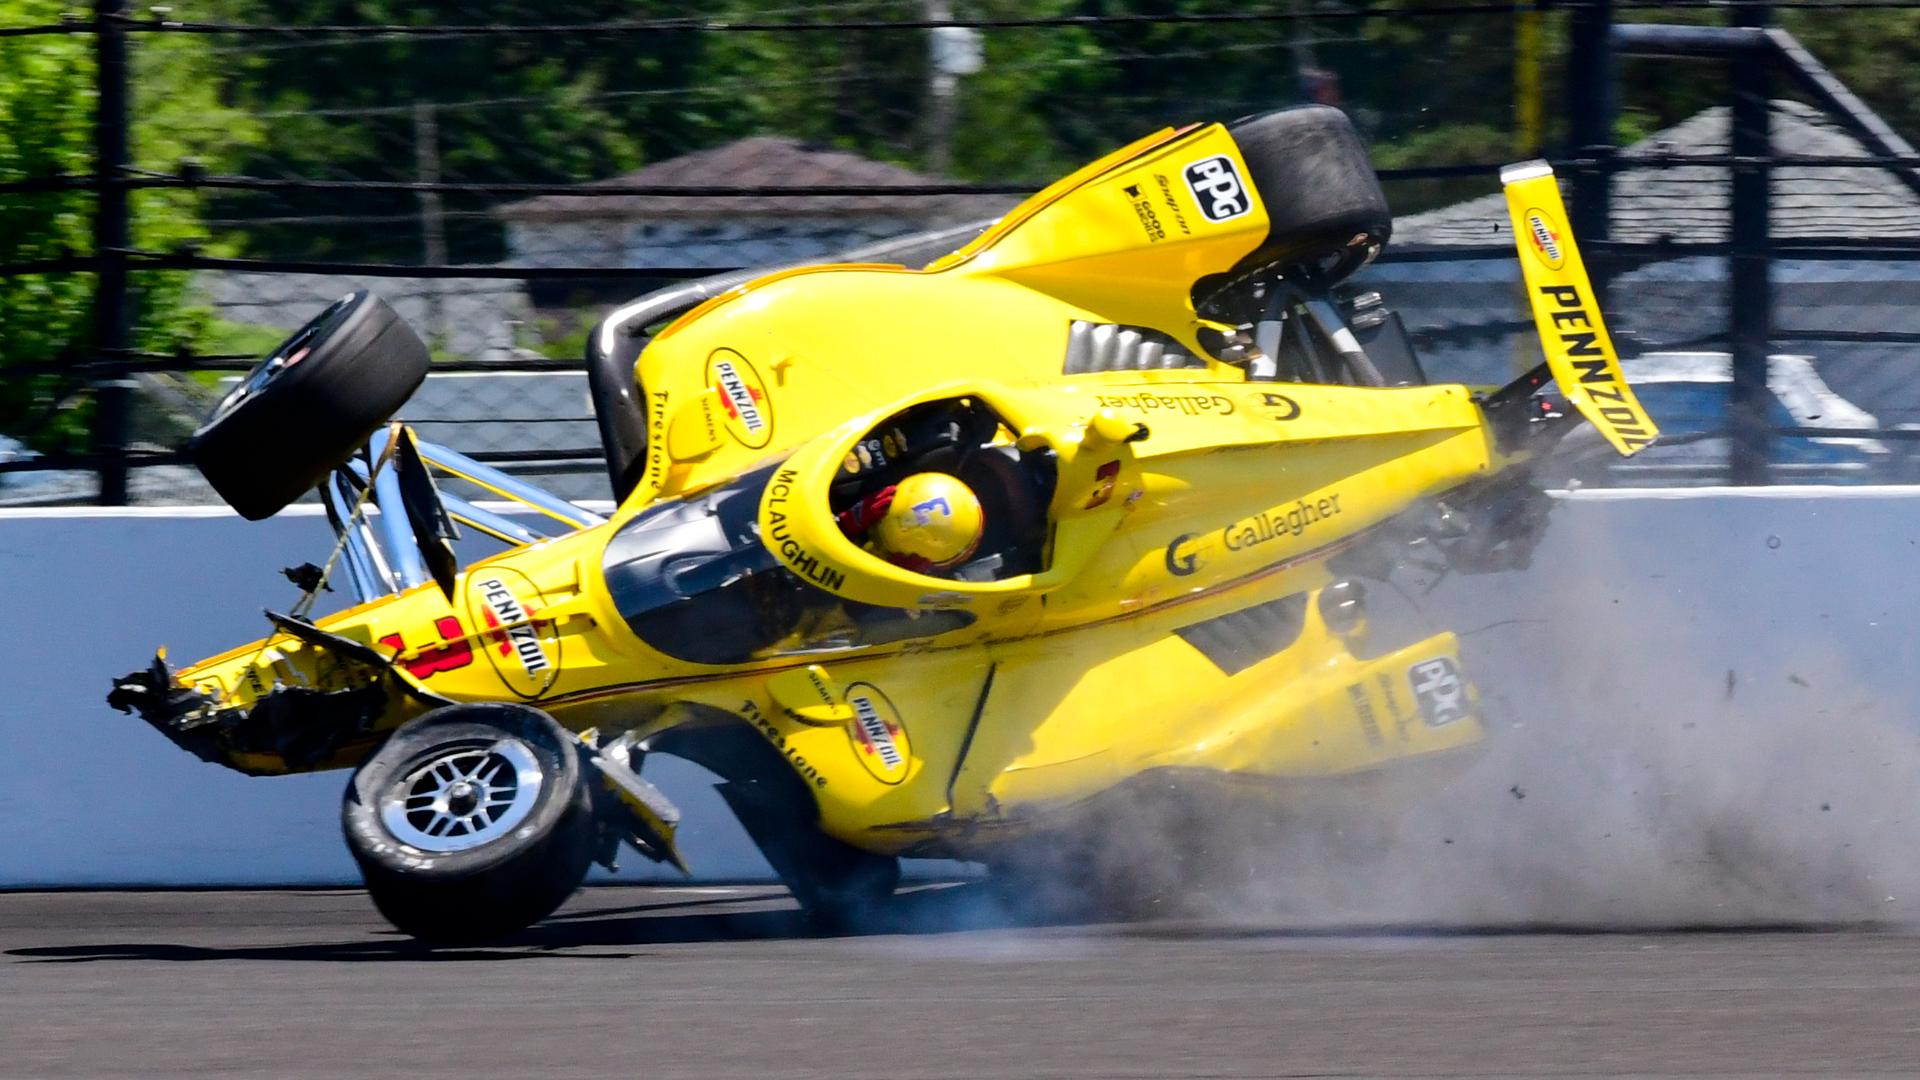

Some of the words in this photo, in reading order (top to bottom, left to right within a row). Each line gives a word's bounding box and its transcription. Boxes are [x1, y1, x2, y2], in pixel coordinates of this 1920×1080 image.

[1141, 200, 1166, 239] GOOD
[1192, 158, 1243, 220] PPG
[1530, 216, 1560, 260] PENNZOIL
[715, 362, 763, 433] PENNZOIL
[1539, 284, 1652, 450] PENNZOIL
[1099, 392, 1234, 416] Gallagher
[650, 390, 668, 490] Firestone
[768, 469, 845, 591] MCLAUGHLIN
[1223, 493, 1342, 551] Gallagher
[477, 579, 549, 680] PENNZOIL
[741, 699, 827, 789] Firestone
[853, 697, 902, 769] PENNZOIL
